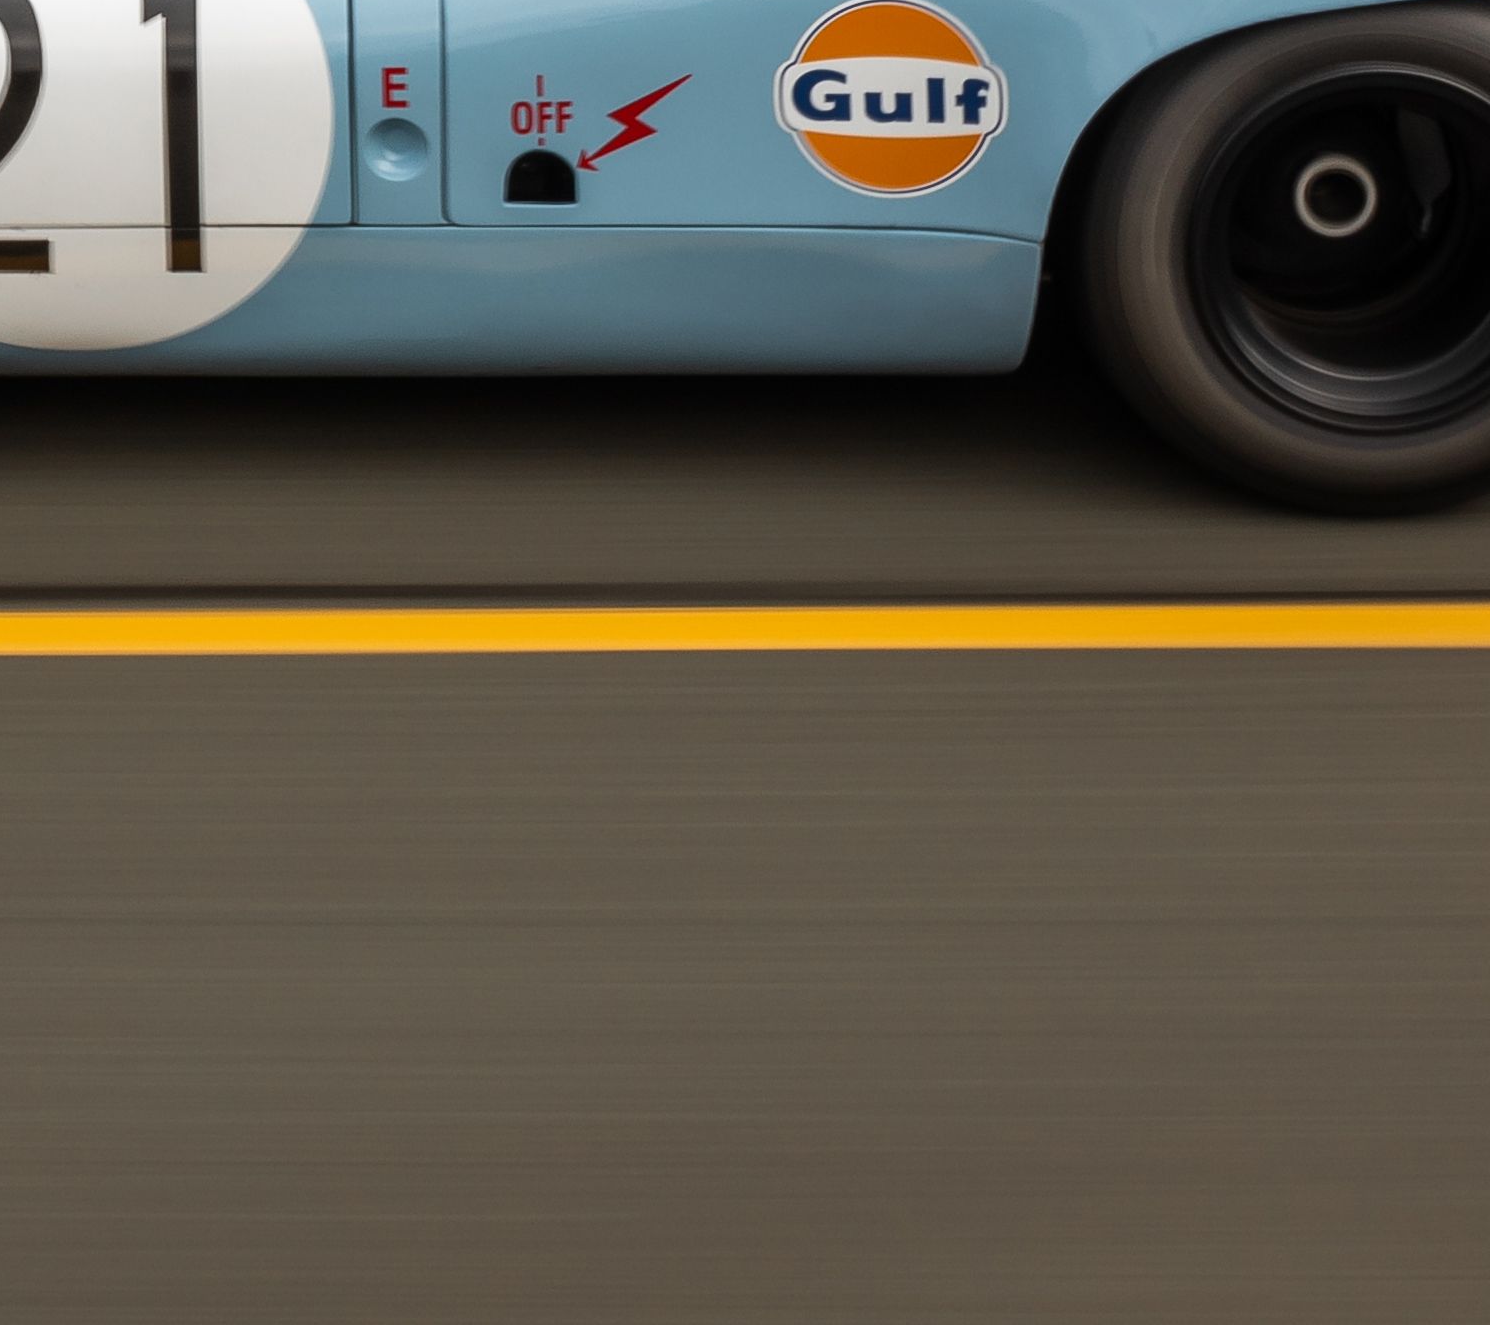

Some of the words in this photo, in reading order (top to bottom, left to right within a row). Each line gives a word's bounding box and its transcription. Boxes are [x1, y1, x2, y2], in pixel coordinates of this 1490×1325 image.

[381, 66, 410, 109] E
[791, 68, 990, 125] Gulf
[510, 100, 574, 135] OFF
